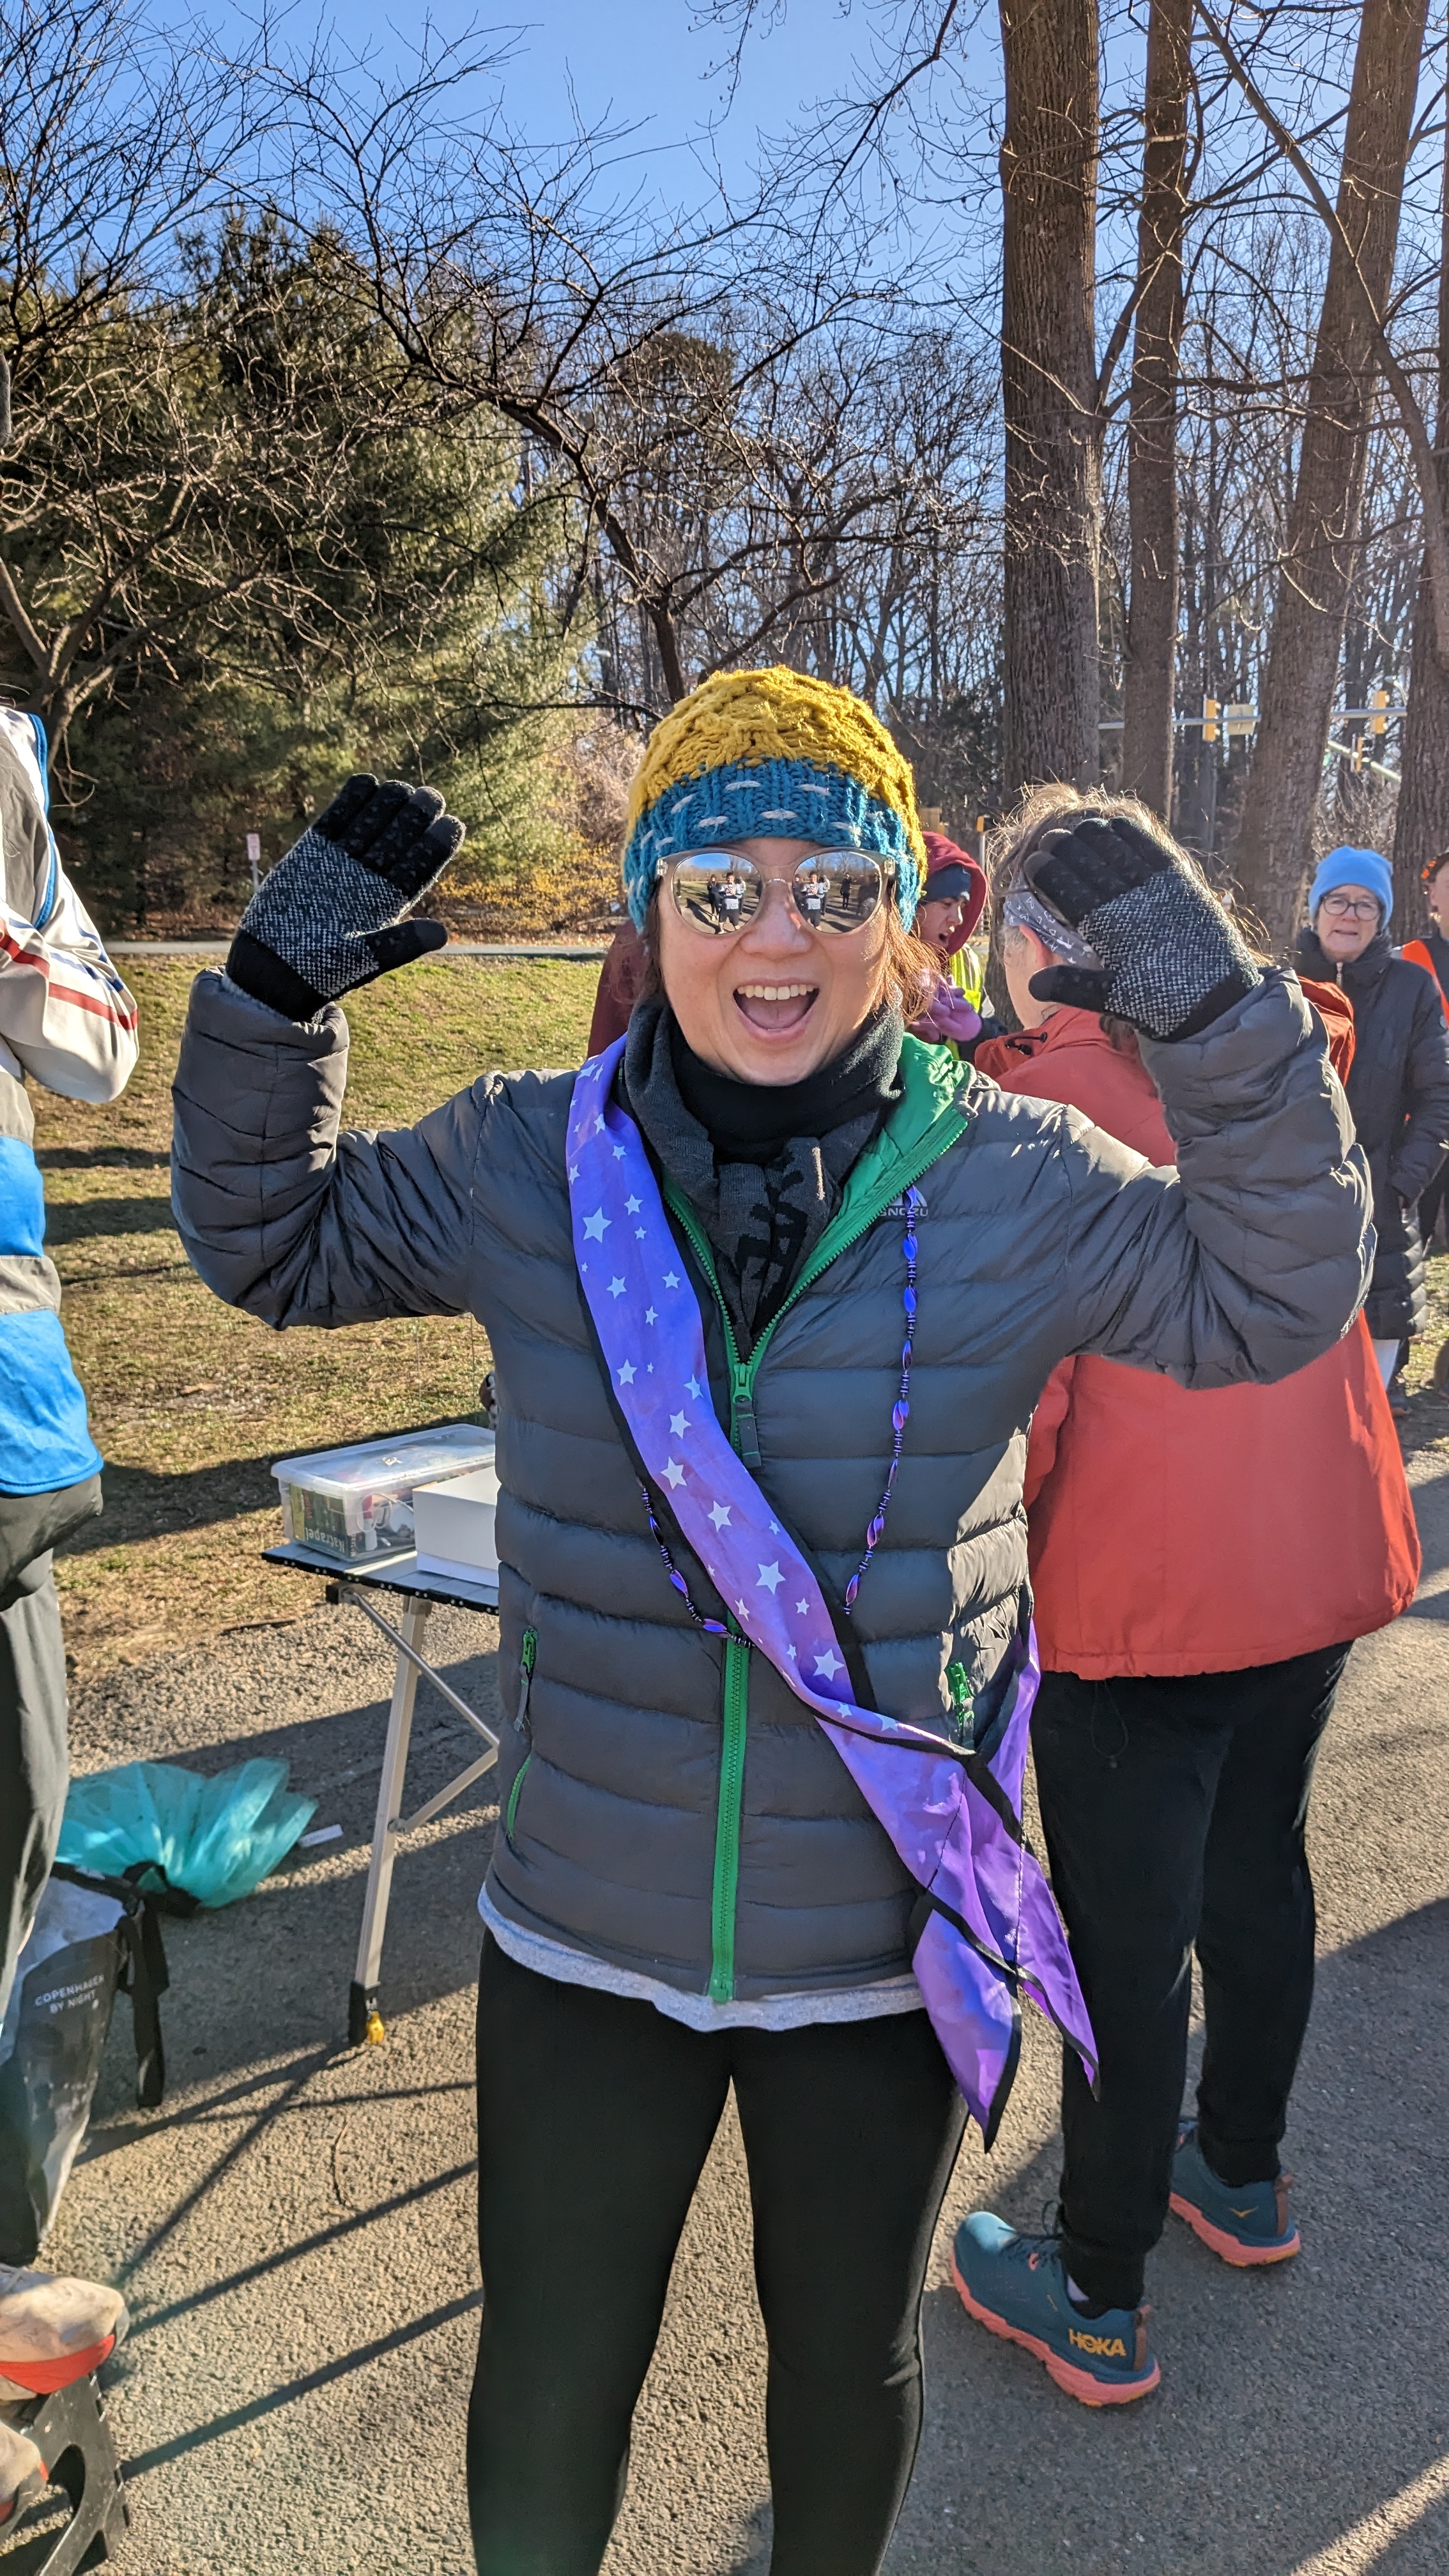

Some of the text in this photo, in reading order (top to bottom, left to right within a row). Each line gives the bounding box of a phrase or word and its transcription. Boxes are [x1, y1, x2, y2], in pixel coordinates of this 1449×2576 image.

[305, 1528, 345, 1553] Natrapel
[34, 1974, 104, 2006] COPENHAGEN
[50, 1989, 95, 2014] BY NIGHT
[1068, 2328, 1126, 2357] HOKA
